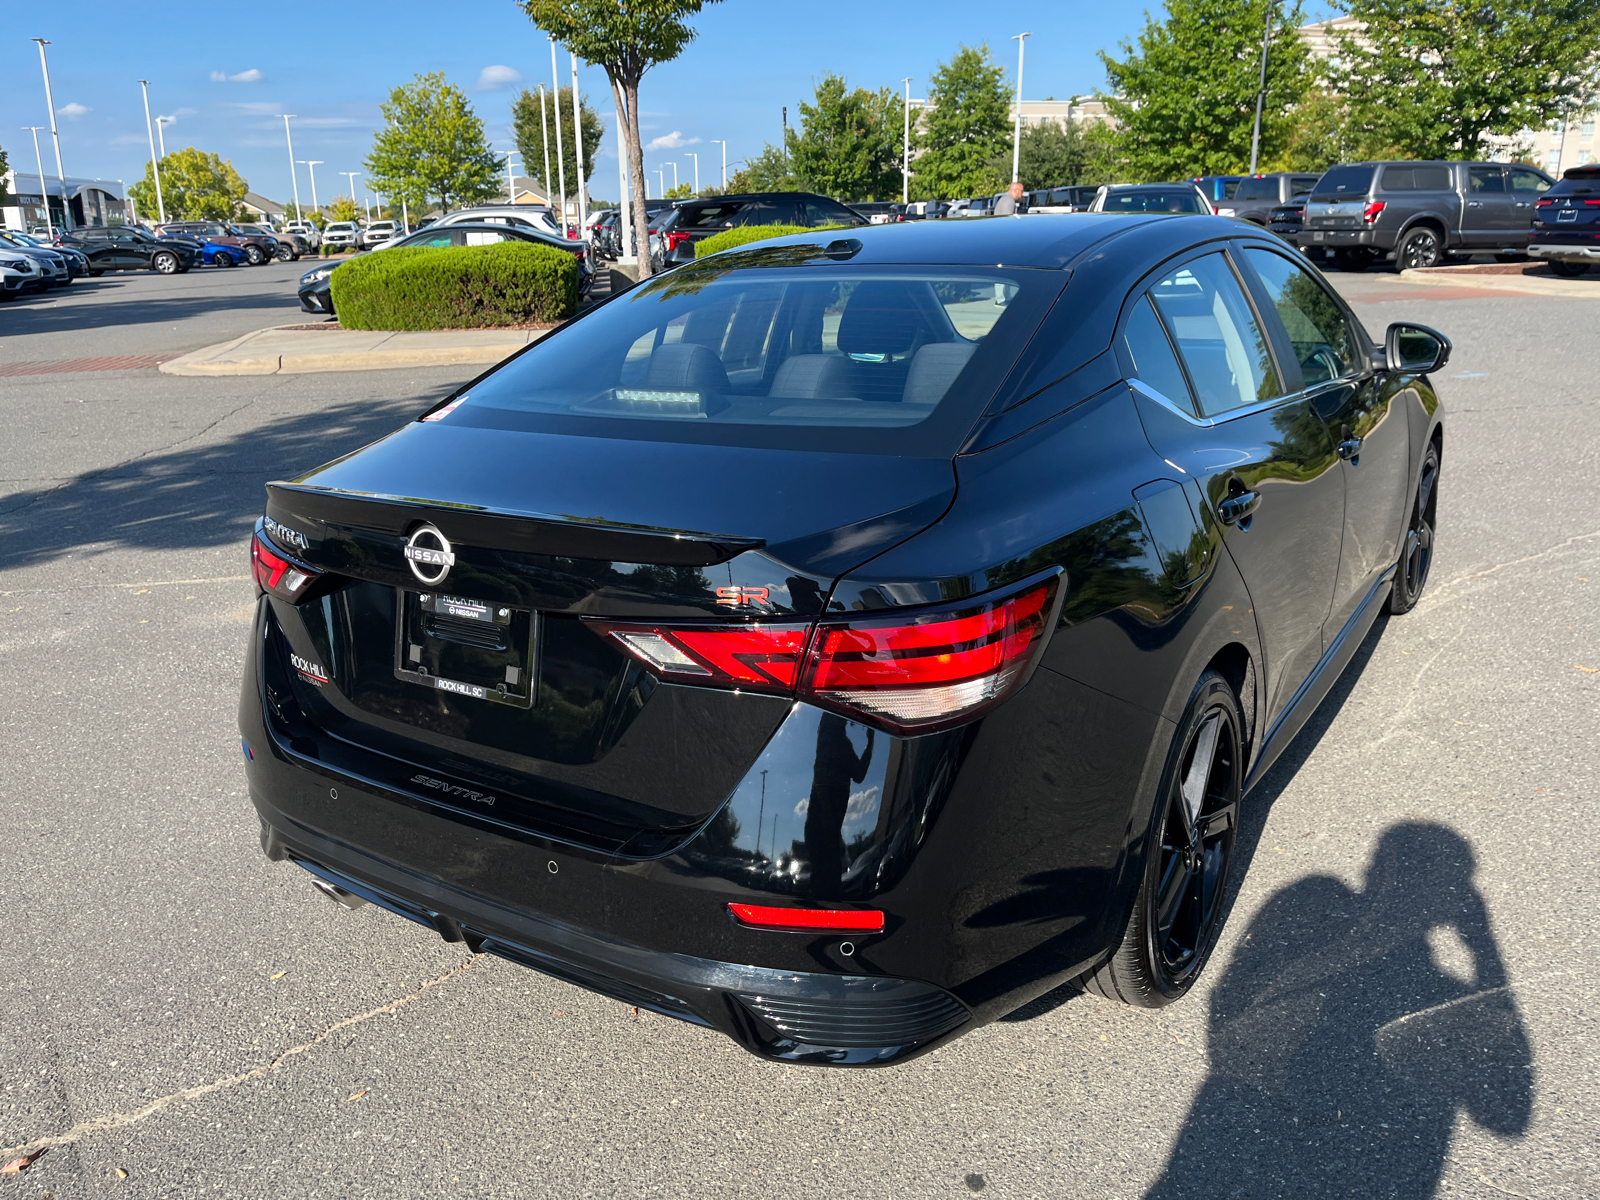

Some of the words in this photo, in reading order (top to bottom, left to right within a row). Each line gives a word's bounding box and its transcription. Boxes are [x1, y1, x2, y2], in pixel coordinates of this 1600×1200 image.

[265, 516, 309, 549] SENTRA
[404, 547, 454, 565] NISSAN
[716, 586, 770, 605] SR
[456, 608, 478, 618] NISSAN
[291, 653, 310, 673] ROCK
[309, 662, 328, 679] HILL
[438, 679, 456, 691] ROCK
[472, 687, 482, 697] SC
[410, 775, 495, 806] SENTRA
